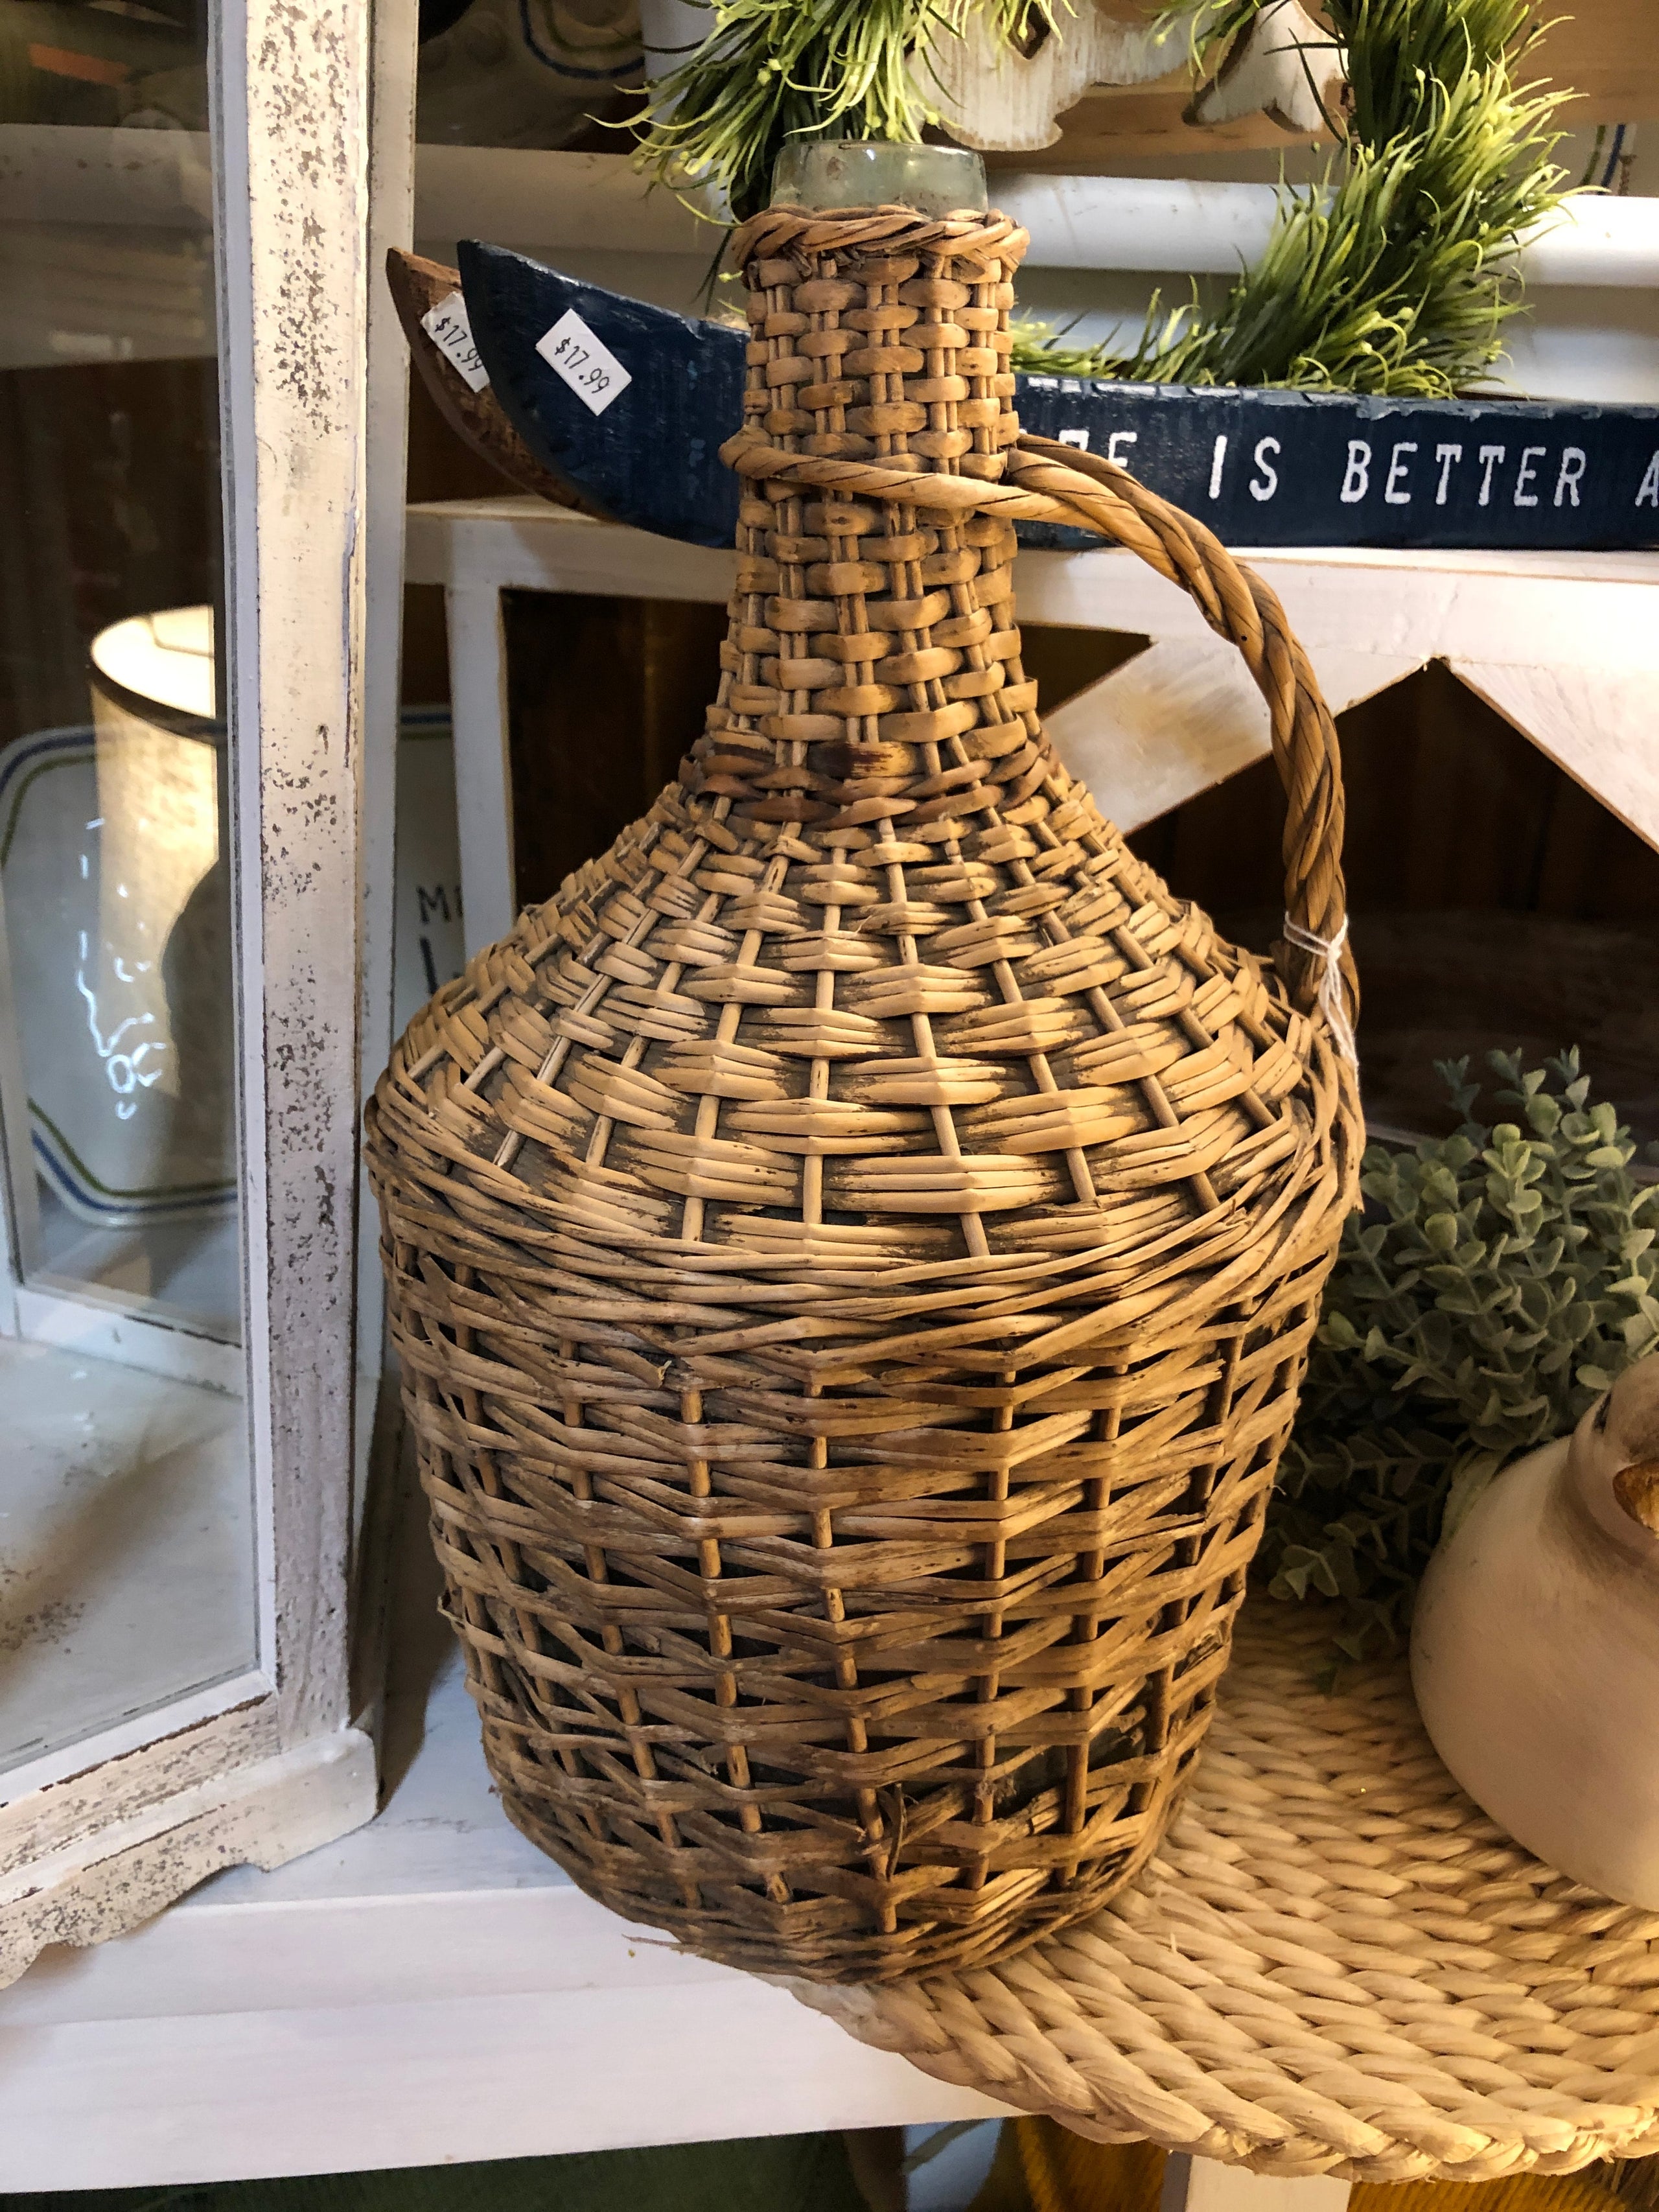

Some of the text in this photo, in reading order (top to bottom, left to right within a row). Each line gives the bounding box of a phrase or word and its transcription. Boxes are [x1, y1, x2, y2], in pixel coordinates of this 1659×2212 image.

[434, 316, 484, 372] $17.99
[554, 337, 610, 394] $17.99
[1208, 435, 1281, 502] IS
[1340, 439, 1586, 507] BETTER
